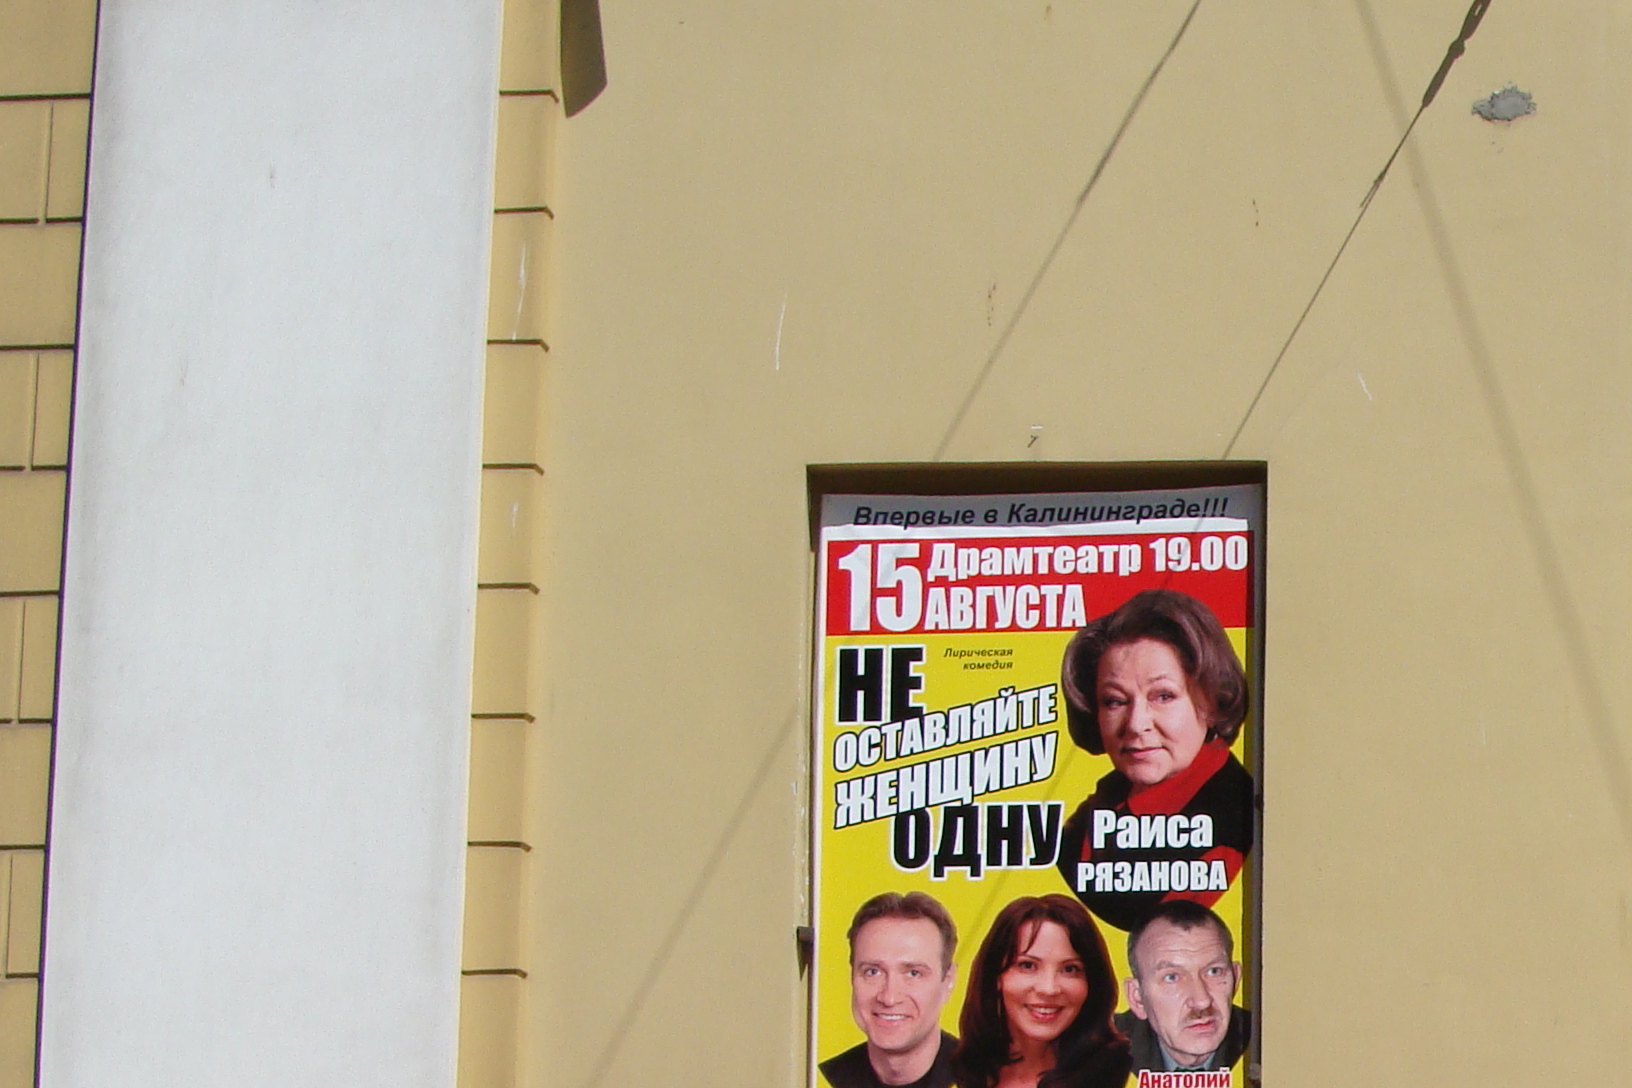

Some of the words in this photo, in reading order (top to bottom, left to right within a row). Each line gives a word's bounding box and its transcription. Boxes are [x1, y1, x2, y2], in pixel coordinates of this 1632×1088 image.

[852, 505, 976, 528] Впервые
[983, 508, 998, 524] в
[1006, 497, 1229, 526] Калининграде!!!
[926, 541, 1141, 583] Драмтеатр
[1148, 534, 1249, 573] 19.00
[837, 543, 923, 633] 15
[924, 583, 1088, 632] АВГУСТА
[943, 647, 1014, 660] Лирическая
[962, 660, 1014, 672] комедия
[835, 643, 926, 726] НЕ
[833, 682, 1058, 773] ОСТАВЛЯЙТЕ
[833, 732, 1058, 830] ЖЕНЩИНУ
[890, 801, 1065, 884] ОДНУ
[1092, 808, 1215, 851] Раиса
[1076, 859, 1229, 895] РЯЗАНОВА
